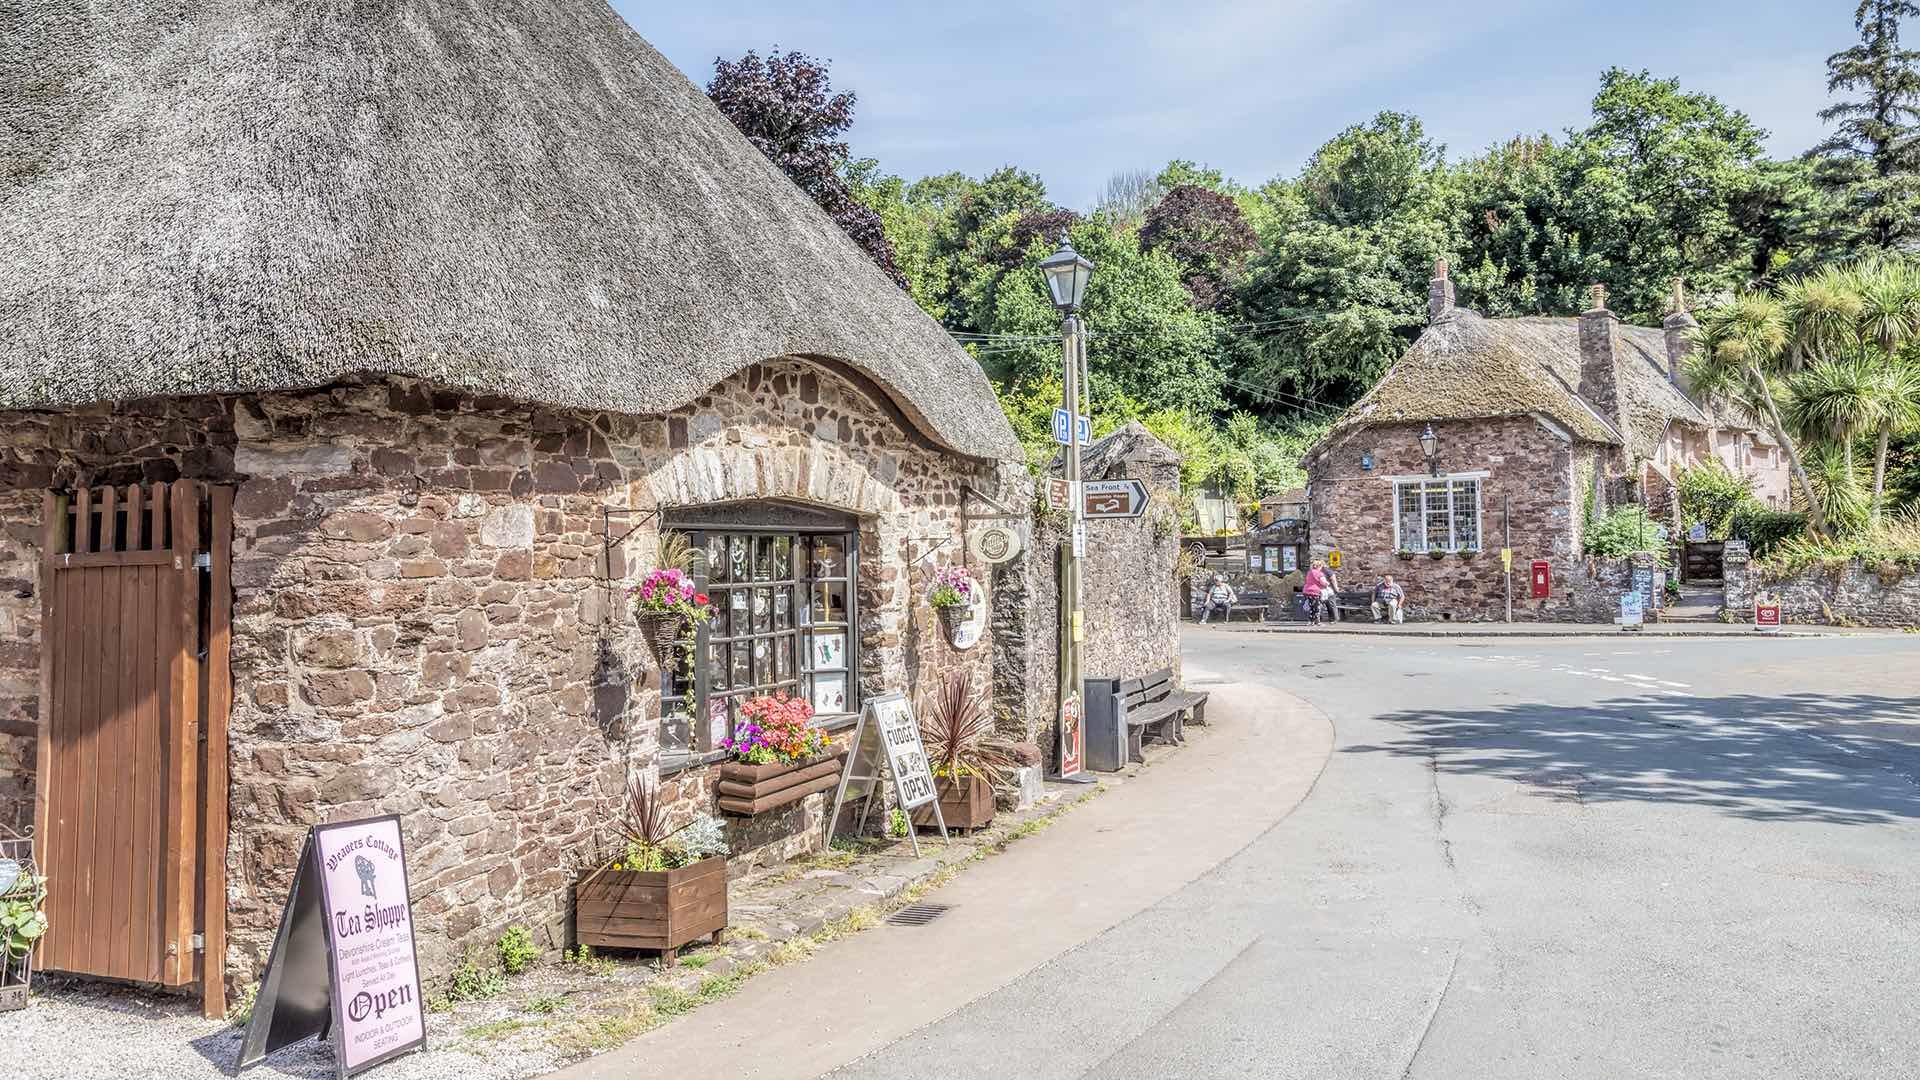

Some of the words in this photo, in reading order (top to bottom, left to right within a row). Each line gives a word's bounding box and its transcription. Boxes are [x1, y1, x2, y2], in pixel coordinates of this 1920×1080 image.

[1101, 483, 1120, 491] Front
[887, 726, 915, 747] FUDGE
[902, 776, 931, 801] OPEN
[326, 839, 364, 872] Weavers
[366, 835, 398, 861] Cottage
[335, 911, 362, 939] Tea
[364, 903, 406, 934] Shoppe
[348, 984, 413, 1022] Open
